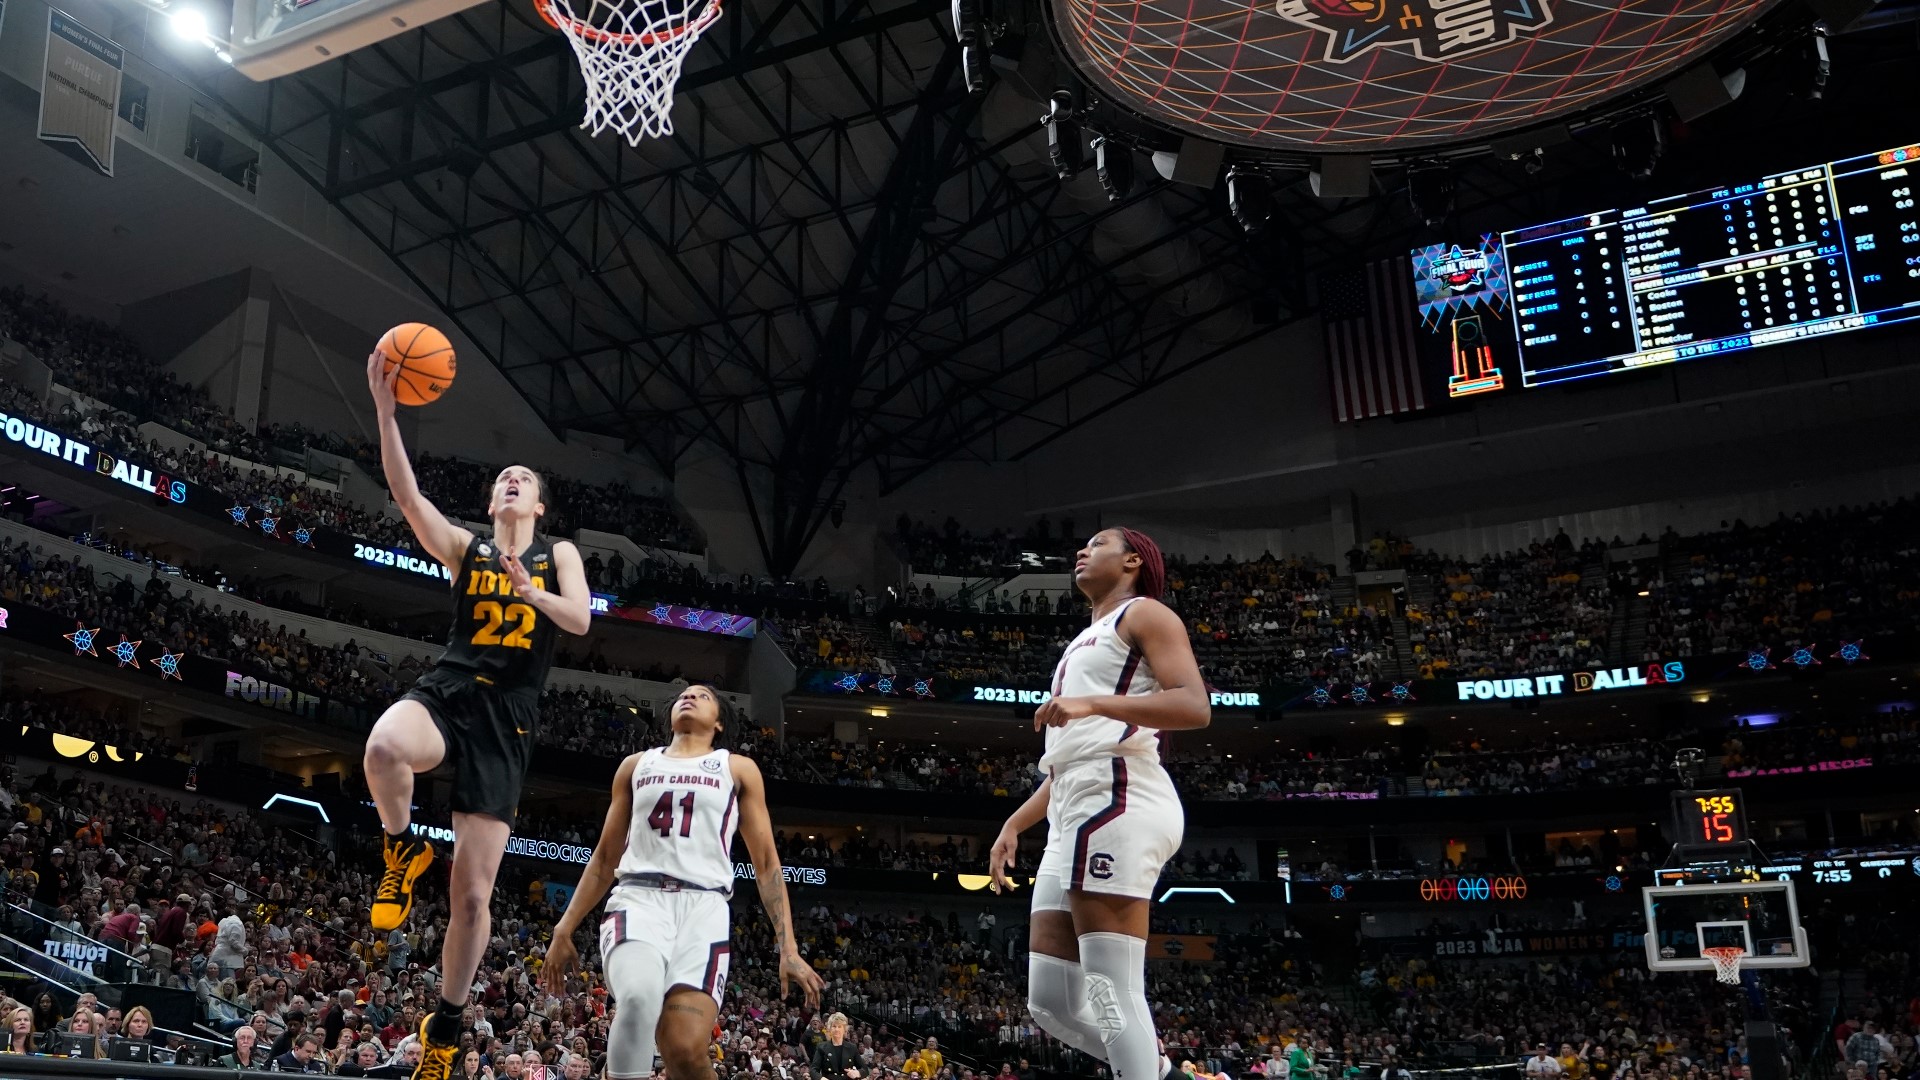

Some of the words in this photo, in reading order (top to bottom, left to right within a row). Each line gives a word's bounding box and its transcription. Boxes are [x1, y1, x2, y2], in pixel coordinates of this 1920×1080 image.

[62, 24, 88, 44] WOMEN'S
[88, 39, 103, 53] FINAL
[103, 48, 119, 61] FOUR
[48, 70, 77, 92] NATIONAL
[78, 86, 114, 110] CHAMPIONS
[1712, 190, 1729, 199] PTS
[1735, 184, 1752, 194] REB
[1622, 223, 1634, 232] 14
[1636, 214, 1676, 228] Warnock
[1562, 237, 1584, 246] IOWA
[1624, 234, 1636, 242] 20
[1637, 228, 1670, 240] Martin
[1625, 245, 1638, 254] 22
[1639, 240, 1664, 251] Clark
[1817, 245, 1837, 254] FLS
[1627, 256, 1640, 265] 24
[1641, 247, 1681, 262] Marshall
[1432, 261, 1458, 279] FINAL
[1459, 258, 1486, 272] FOUR
[1513, 261, 1548, 273] ASSISTS
[1629, 267, 1642, 276] 25
[1532, 274, 1554, 284] REBS
[1664, 270, 1709, 284] CAROLINA
[1534, 289, 1556, 298] REBS
[1647, 289, 1677, 300] Cooke
[1536, 303, 1558, 312] REBS
[1649, 300, 1684, 312] Boston
[1522, 324, 1535, 332] TO
[1524, 334, 1557, 346] STEALS
[1655, 333, 1693, 346] Fletcher
[1681, 345, 1696, 357] TO
[1697, 342, 1720, 355] THE
[1722, 338, 1749, 350] 2023
[1808, 320, 1843, 335] FINAL
[1844, 315, 1878, 328] FOUR
[63, 438, 90, 466] IT
[96, 451, 186, 504] DALLAS
[354, 543, 395, 566] 2023
[396, 554, 440, 578] NCAA
[471, 600, 537, 650] 22
[1457, 677, 1534, 700] FOUR
[1536, 674, 1565, 696] IT
[1572, 661, 1685, 692] DALLAS
[225, 670, 293, 713] FOUR
[296, 690, 321, 718] IT
[973, 687, 1016, 703] 2023
[1018, 690, 1051, 704] NCA
[1210, 692, 1260, 706] FOUR
[636, 775, 665, 790] SOUTH
[669, 775, 721, 790] CAROLINA
[1695, 796, 1734, 814] 7:55
[647, 790, 696, 838] 41
[1703, 814, 1733, 842] 15
[1812, 869, 1852, 883] 7:55
[1436, 940, 1476, 955] 2023
[1529, 934, 1605, 951] WOMEN'S
